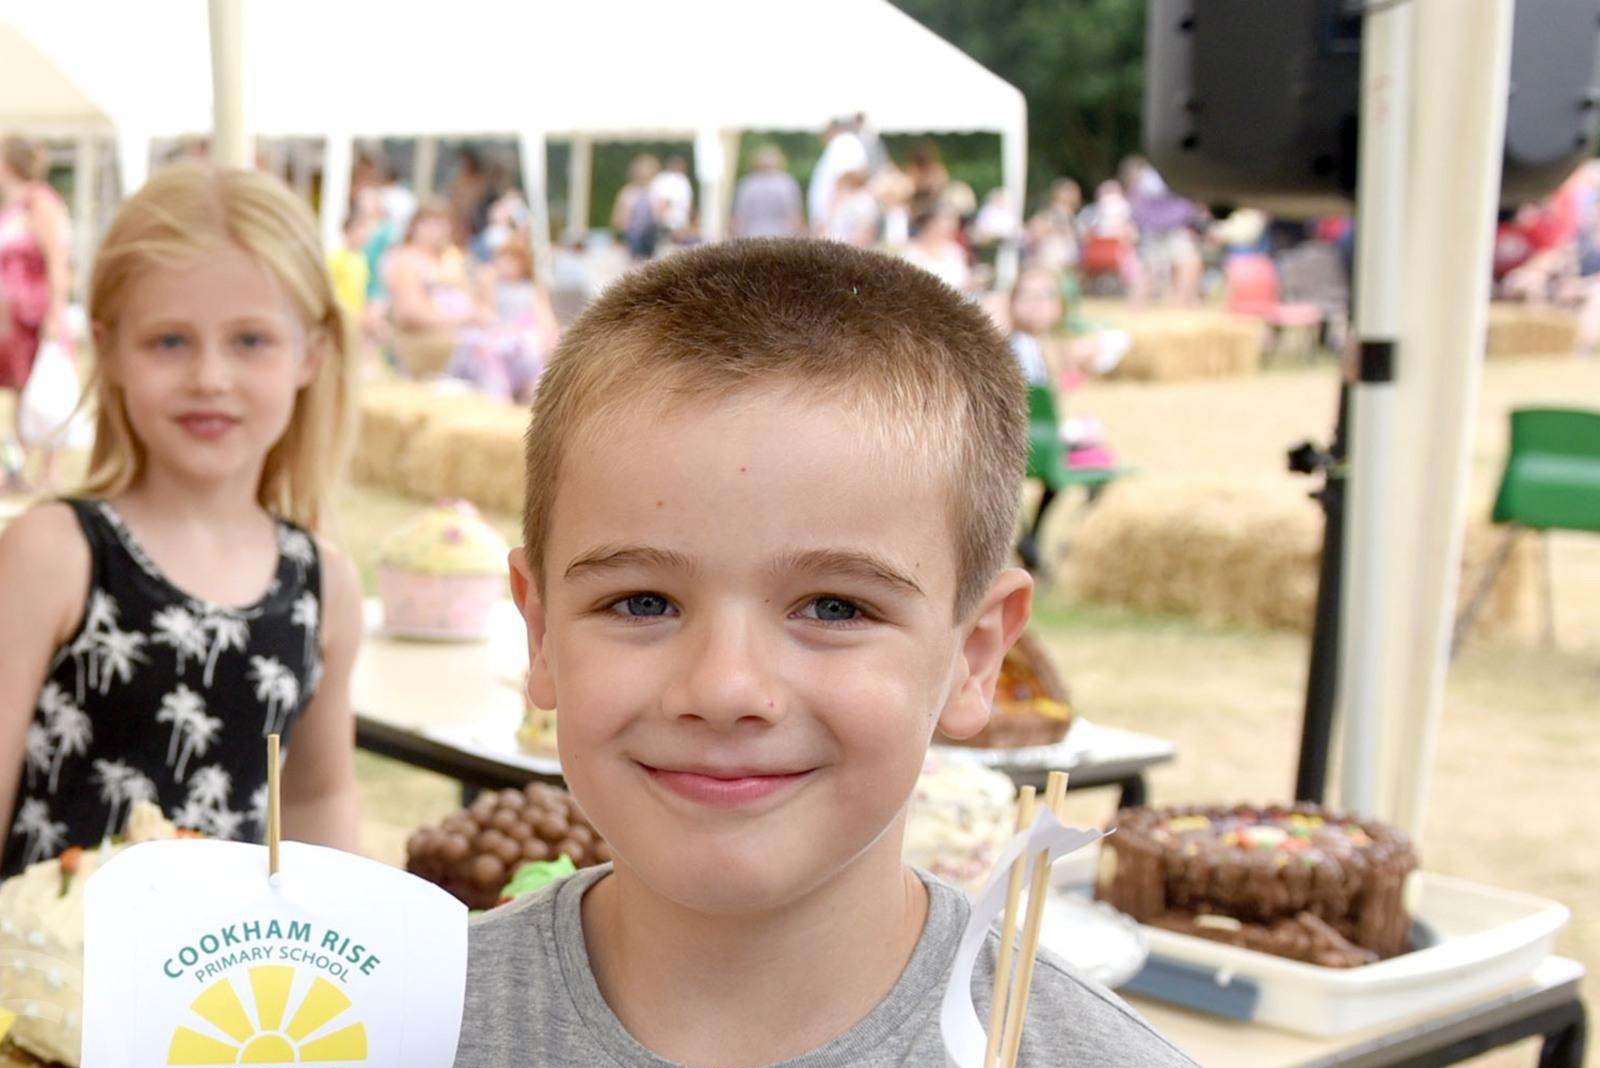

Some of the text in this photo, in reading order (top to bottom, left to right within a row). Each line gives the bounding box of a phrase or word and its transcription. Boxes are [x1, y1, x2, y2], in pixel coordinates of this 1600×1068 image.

[163, 919, 381, 979] COOKHAM RISE
[195, 946, 349, 984] PRIMARY SCHOOL
